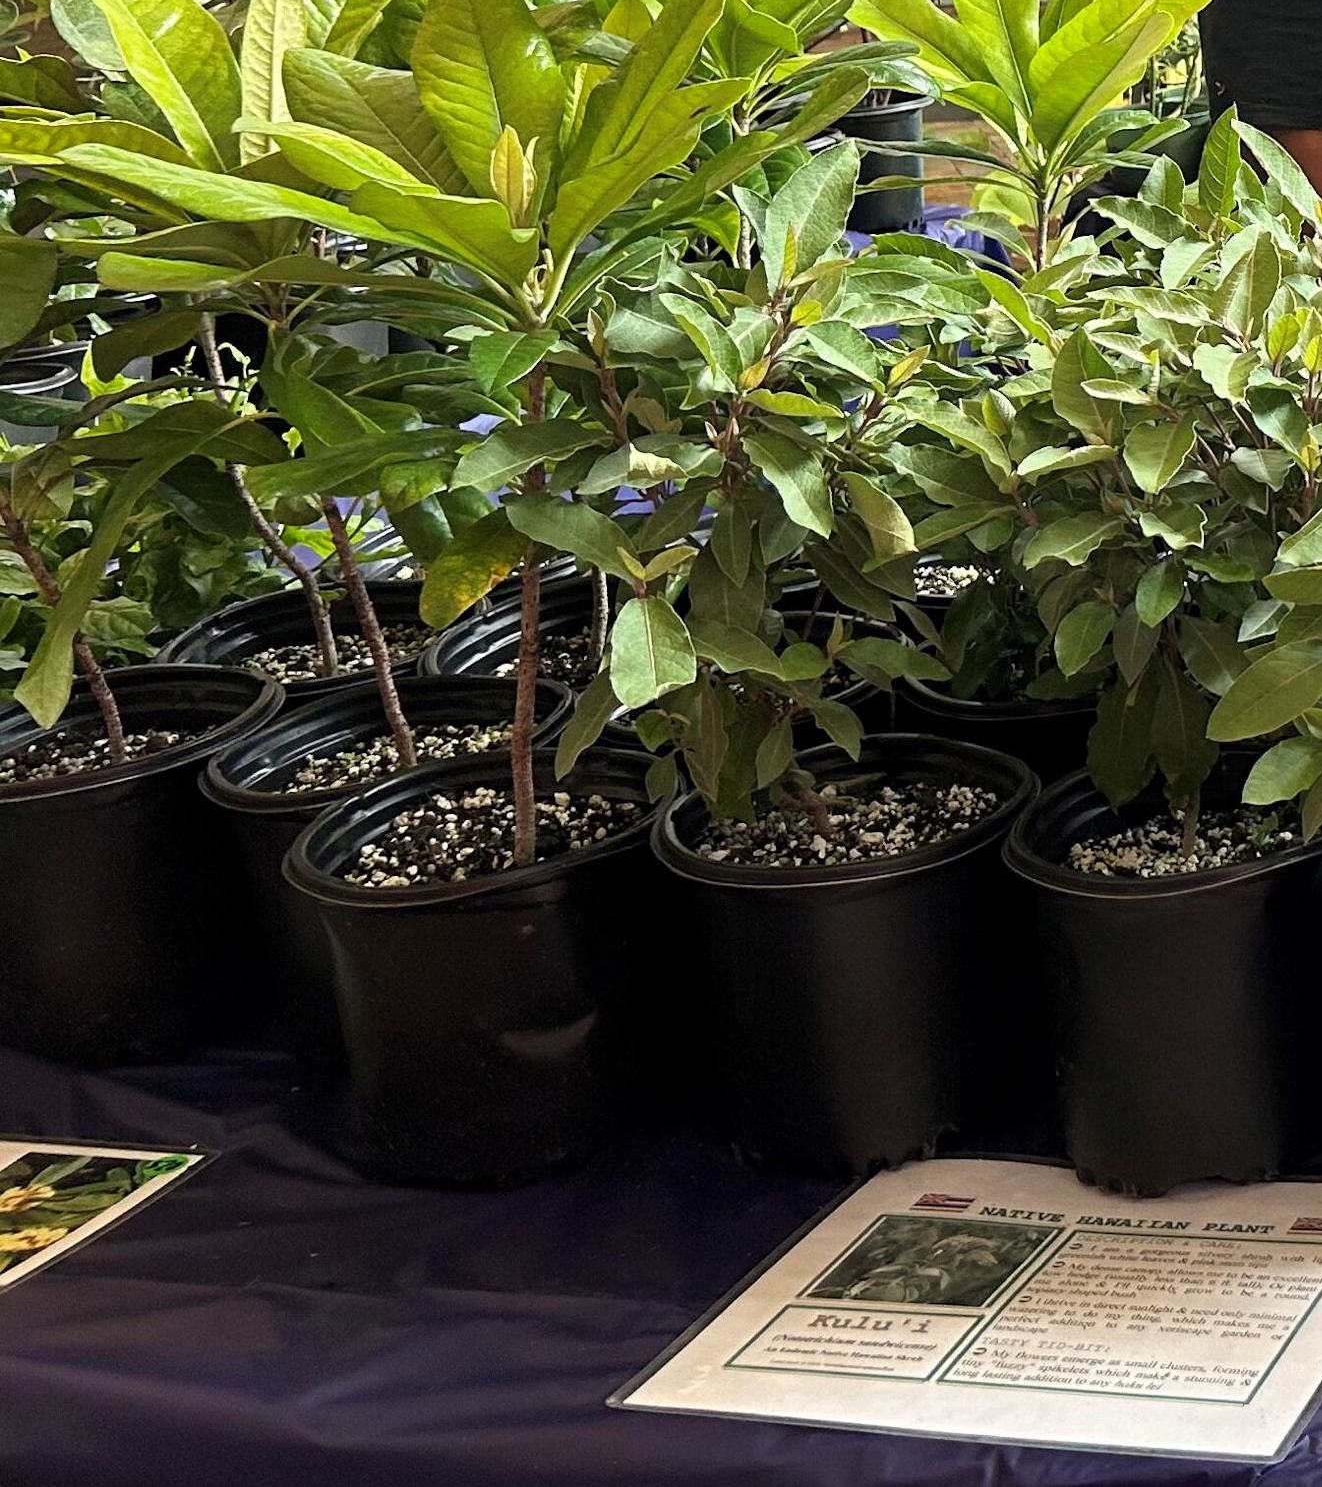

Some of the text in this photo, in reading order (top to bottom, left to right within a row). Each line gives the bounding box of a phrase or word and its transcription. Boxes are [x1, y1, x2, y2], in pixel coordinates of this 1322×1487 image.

[979, 1205, 1275, 1235] NATIVE HAWAIIAN PLANT
[807, 1313, 933, 1334] Kulu'i
[979, 1336, 1112, 1352] TASTY TID-BIT:
[989, 1349, 1012, 1358] My
[1014, 1350, 1061, 1361] flowers
[1059, 1356, 1106, 1366] emerge
[1122, 1358, 1159, 1368] small
[1210, 1365, 1261, 1377] forming
